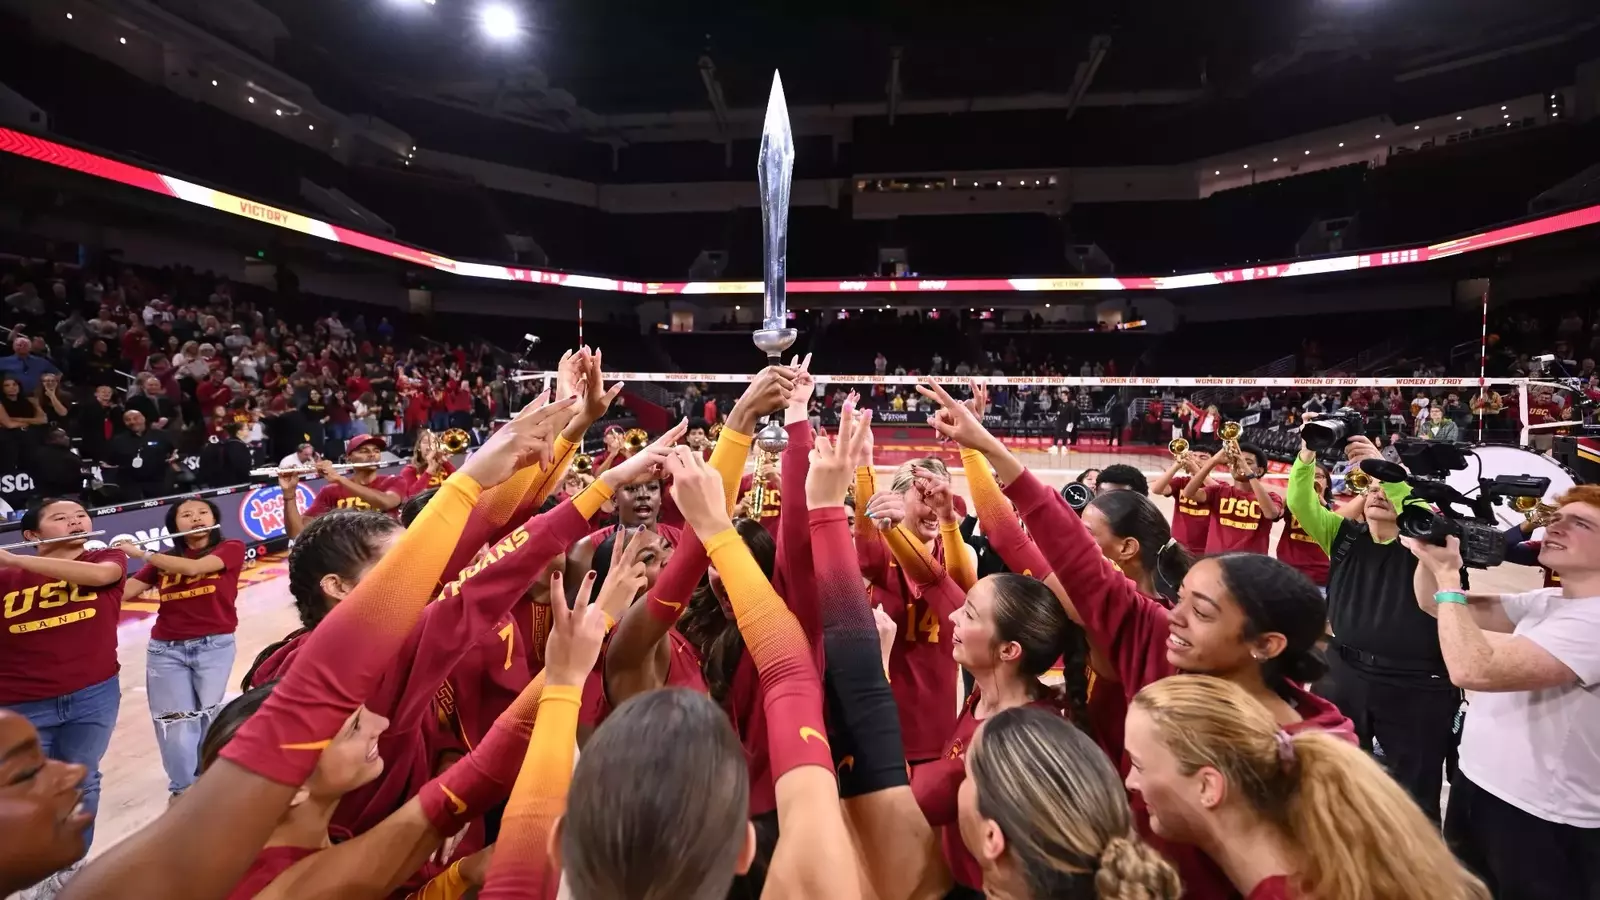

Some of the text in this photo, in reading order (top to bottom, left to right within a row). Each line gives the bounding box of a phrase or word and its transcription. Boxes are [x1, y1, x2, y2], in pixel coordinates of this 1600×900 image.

[240, 201, 288, 224] VICTORY
[1529, 408, 1549, 416] USC
[97, 507, 117, 516] ARCO
[1219, 497, 1262, 519] USC
[3, 580, 98, 619] USC
[166, 586, 210, 600] BAND
[18, 611, 87, 632] BAND
[905, 603, 940, 643] 14
[497, 622, 514, 671] 7
